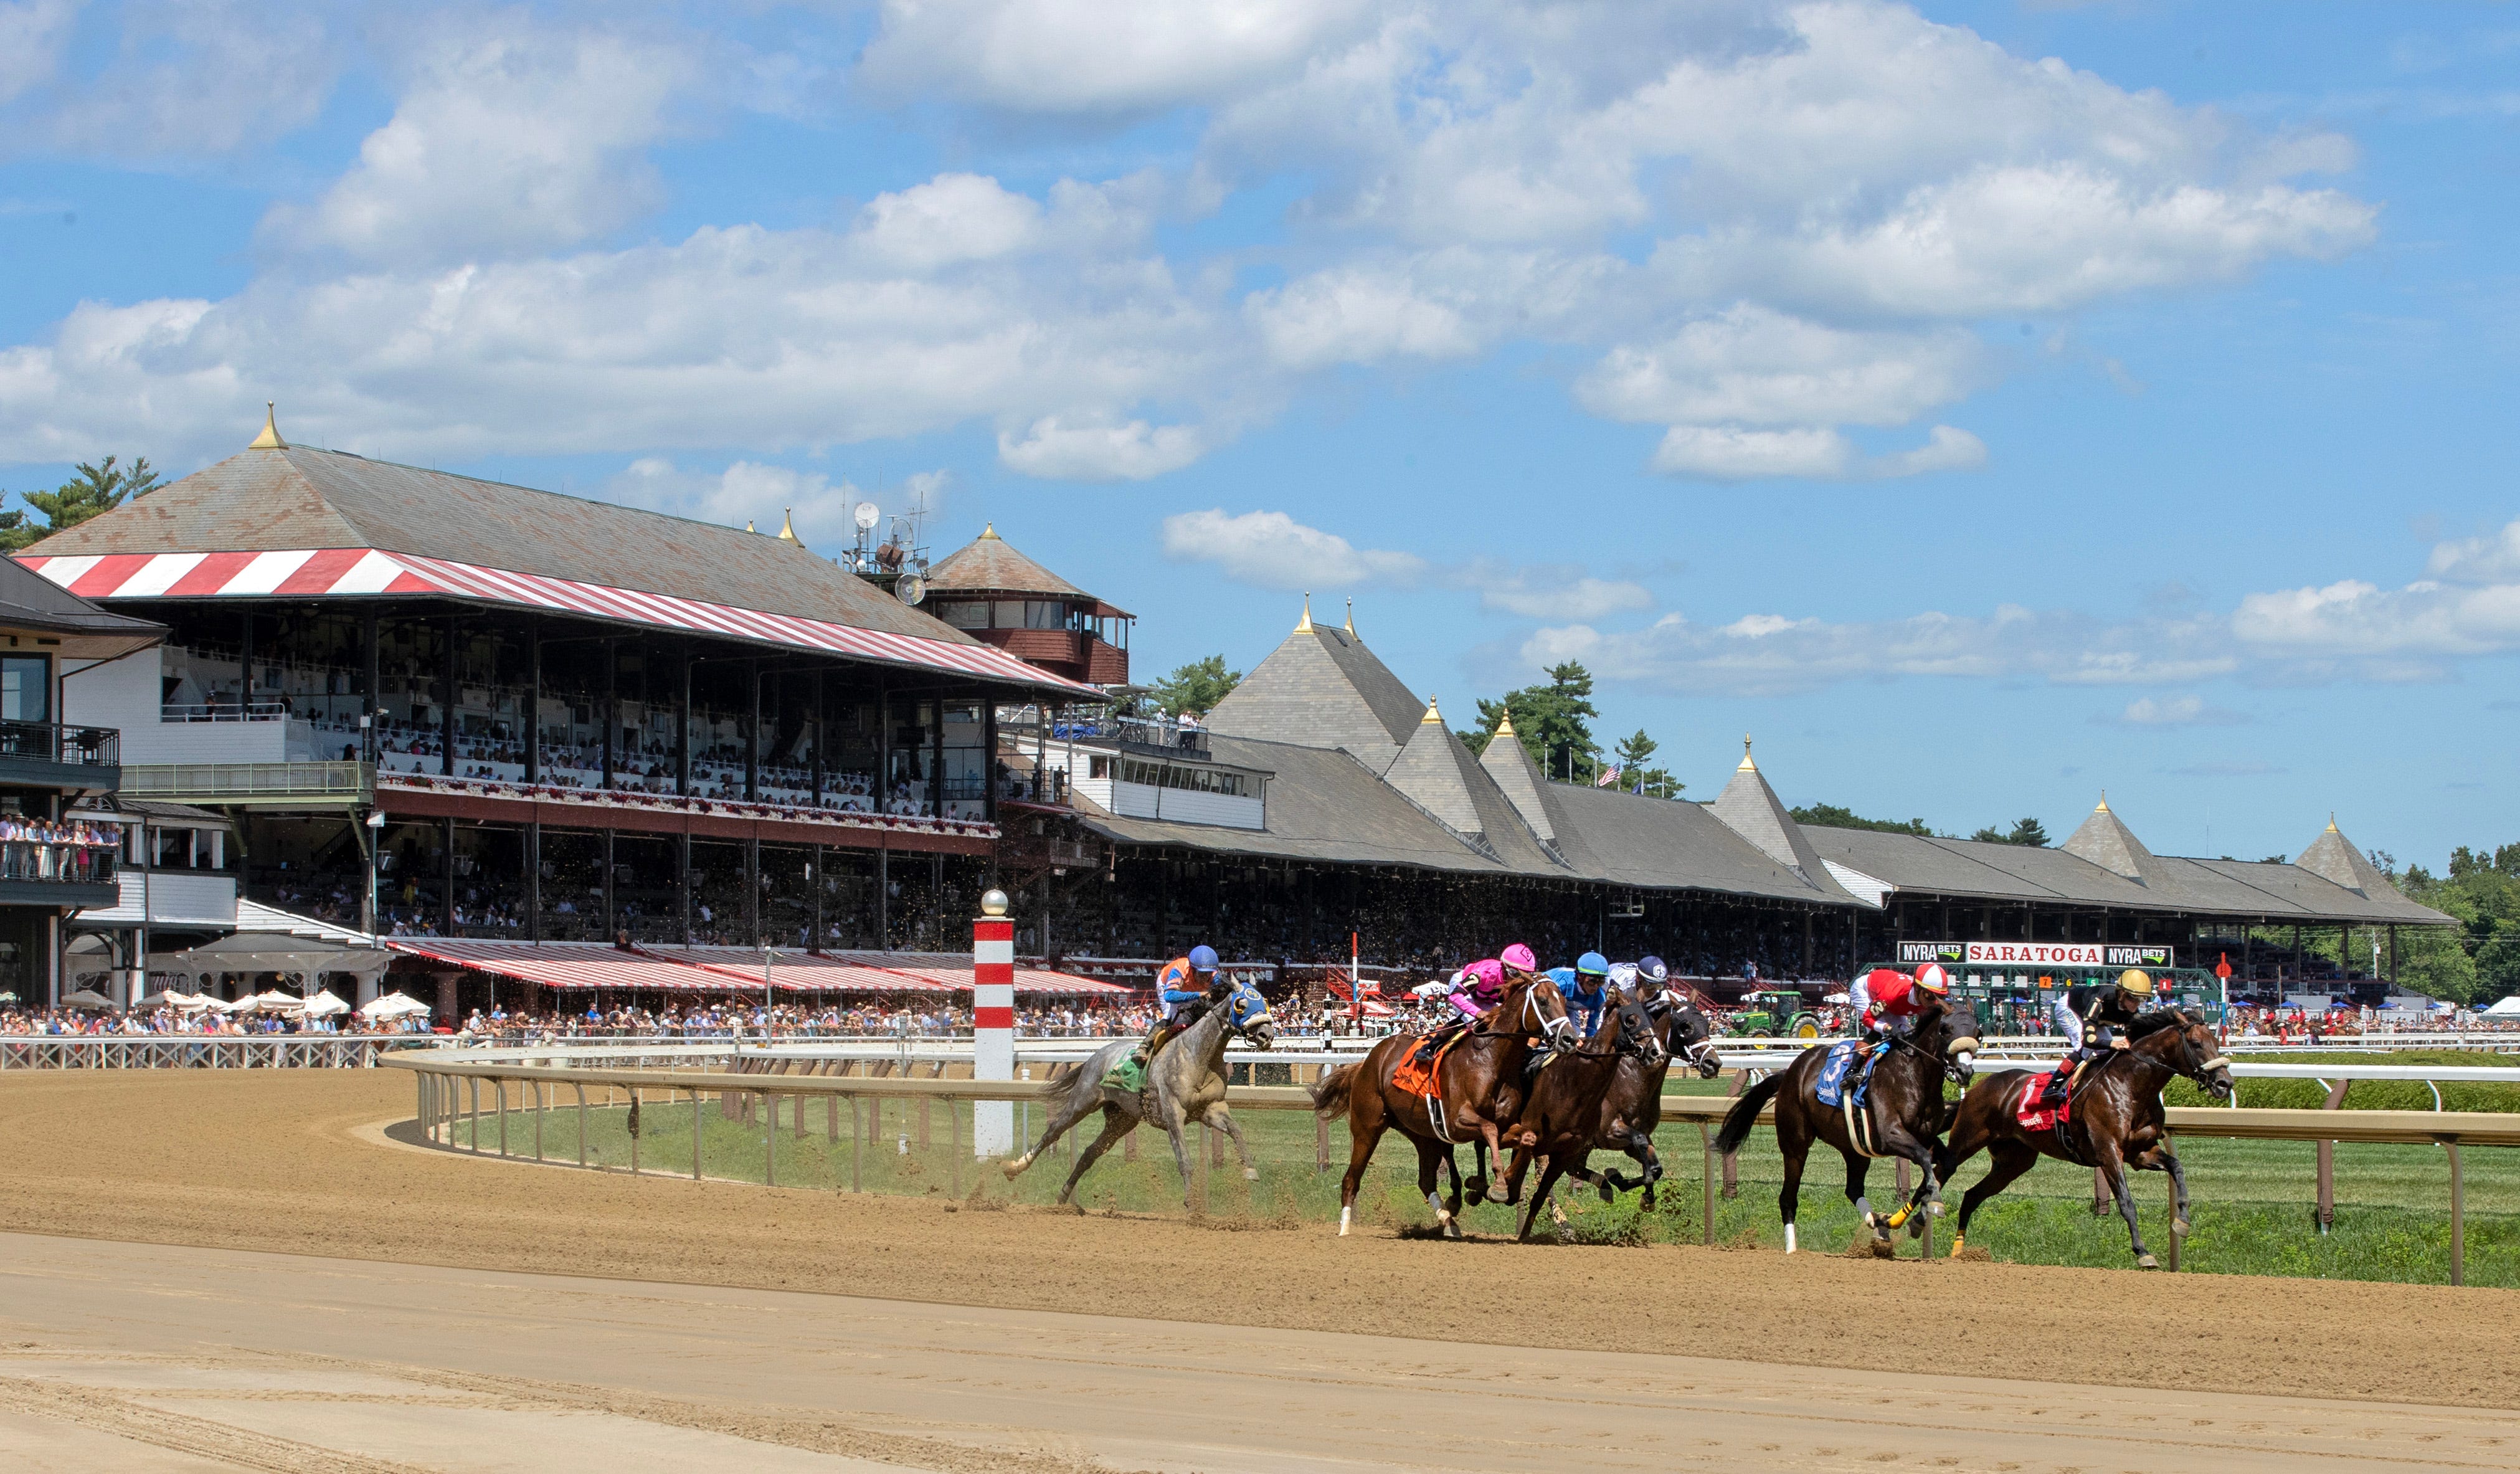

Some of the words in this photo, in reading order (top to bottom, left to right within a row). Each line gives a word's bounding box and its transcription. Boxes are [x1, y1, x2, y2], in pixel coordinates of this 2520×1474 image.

[1903, 944, 1938, 961] NYRA
[1938, 944, 1962, 953] BETS
[1969, 946, 2100, 963] SARATOGA
[2108, 948, 2142, 964] NYRA
[2142, 949, 2166, 957] BETS
[1462, 974, 1480, 988] 7
[2162, 981, 2167, 989] 1
[1870, 1001, 1884, 1017] 3
[1823, 1044, 1851, 1082] 3
[2018, 1078, 2037, 1113] 1
